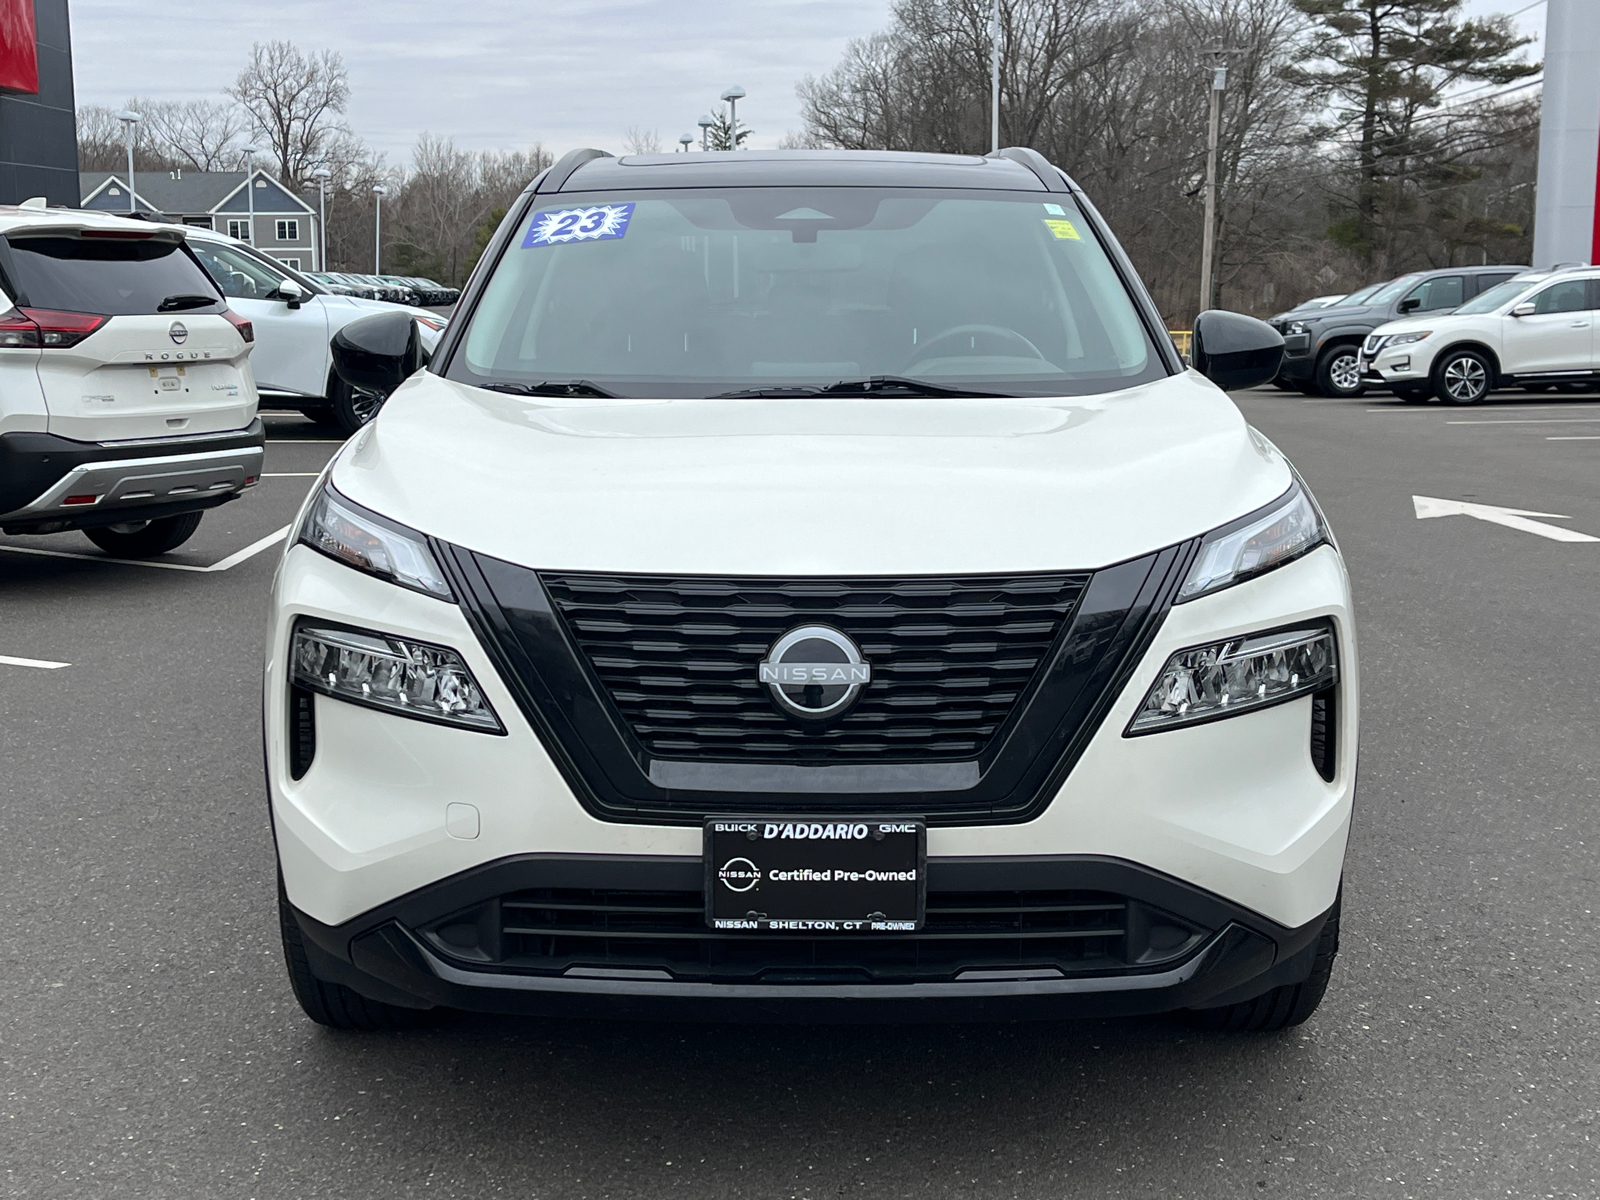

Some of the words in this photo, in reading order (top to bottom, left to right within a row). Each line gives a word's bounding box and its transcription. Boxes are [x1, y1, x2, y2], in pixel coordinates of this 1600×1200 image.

[550, 211, 606, 237] 23
[145, 351, 211, 360] ROGUE
[763, 667, 867, 681] NISSAN
[715, 823, 758, 832] BUICK
[763, 823, 868, 839] D'ADDARIO
[879, 824, 916, 833] GMC
[769, 869, 831, 881] Certified
[834, 869, 916, 881] Pre-Owned
[715, 920, 758, 929] NISSAN
[769, 921, 839, 930] SHELTON,
[843, 921, 863, 930] CT
[871, 922, 915, 930] PRE-OWNED
